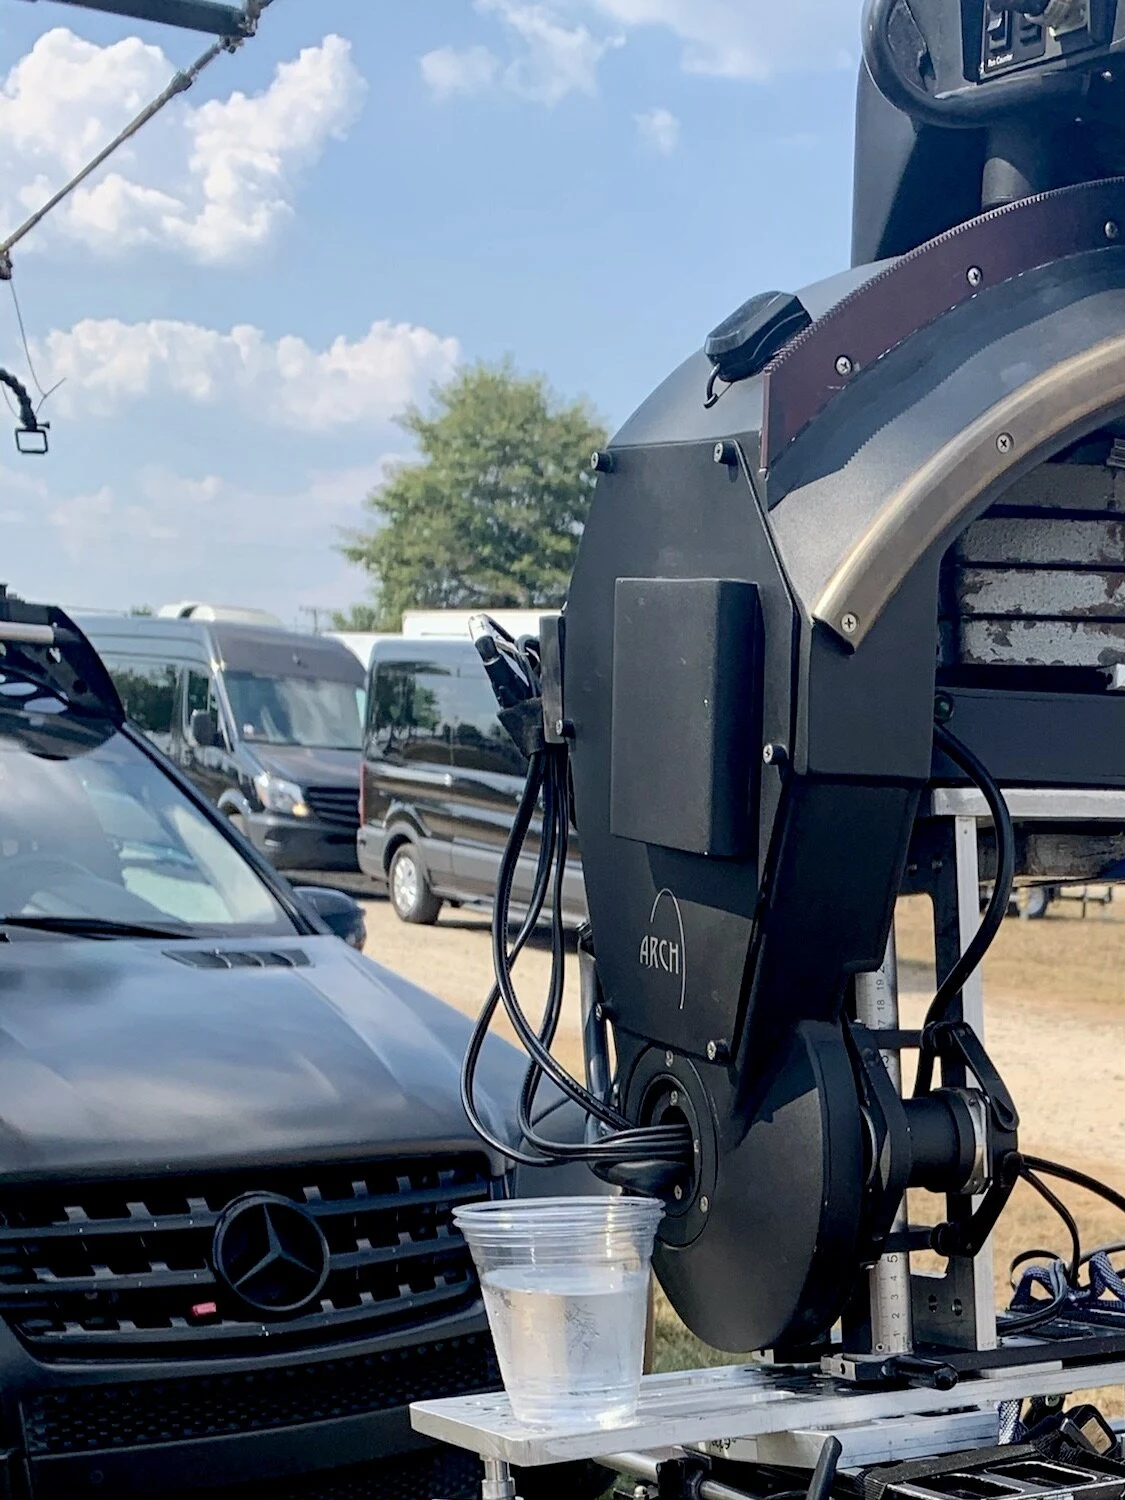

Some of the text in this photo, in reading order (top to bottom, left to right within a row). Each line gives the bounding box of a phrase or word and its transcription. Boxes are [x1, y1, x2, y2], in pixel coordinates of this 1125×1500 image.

[640, 935, 680, 974] ARCH
[876, 979, 885, 991] 19
[877, 1000, 885, 1012] 18
[887, 1254, 898, 1263] 5
